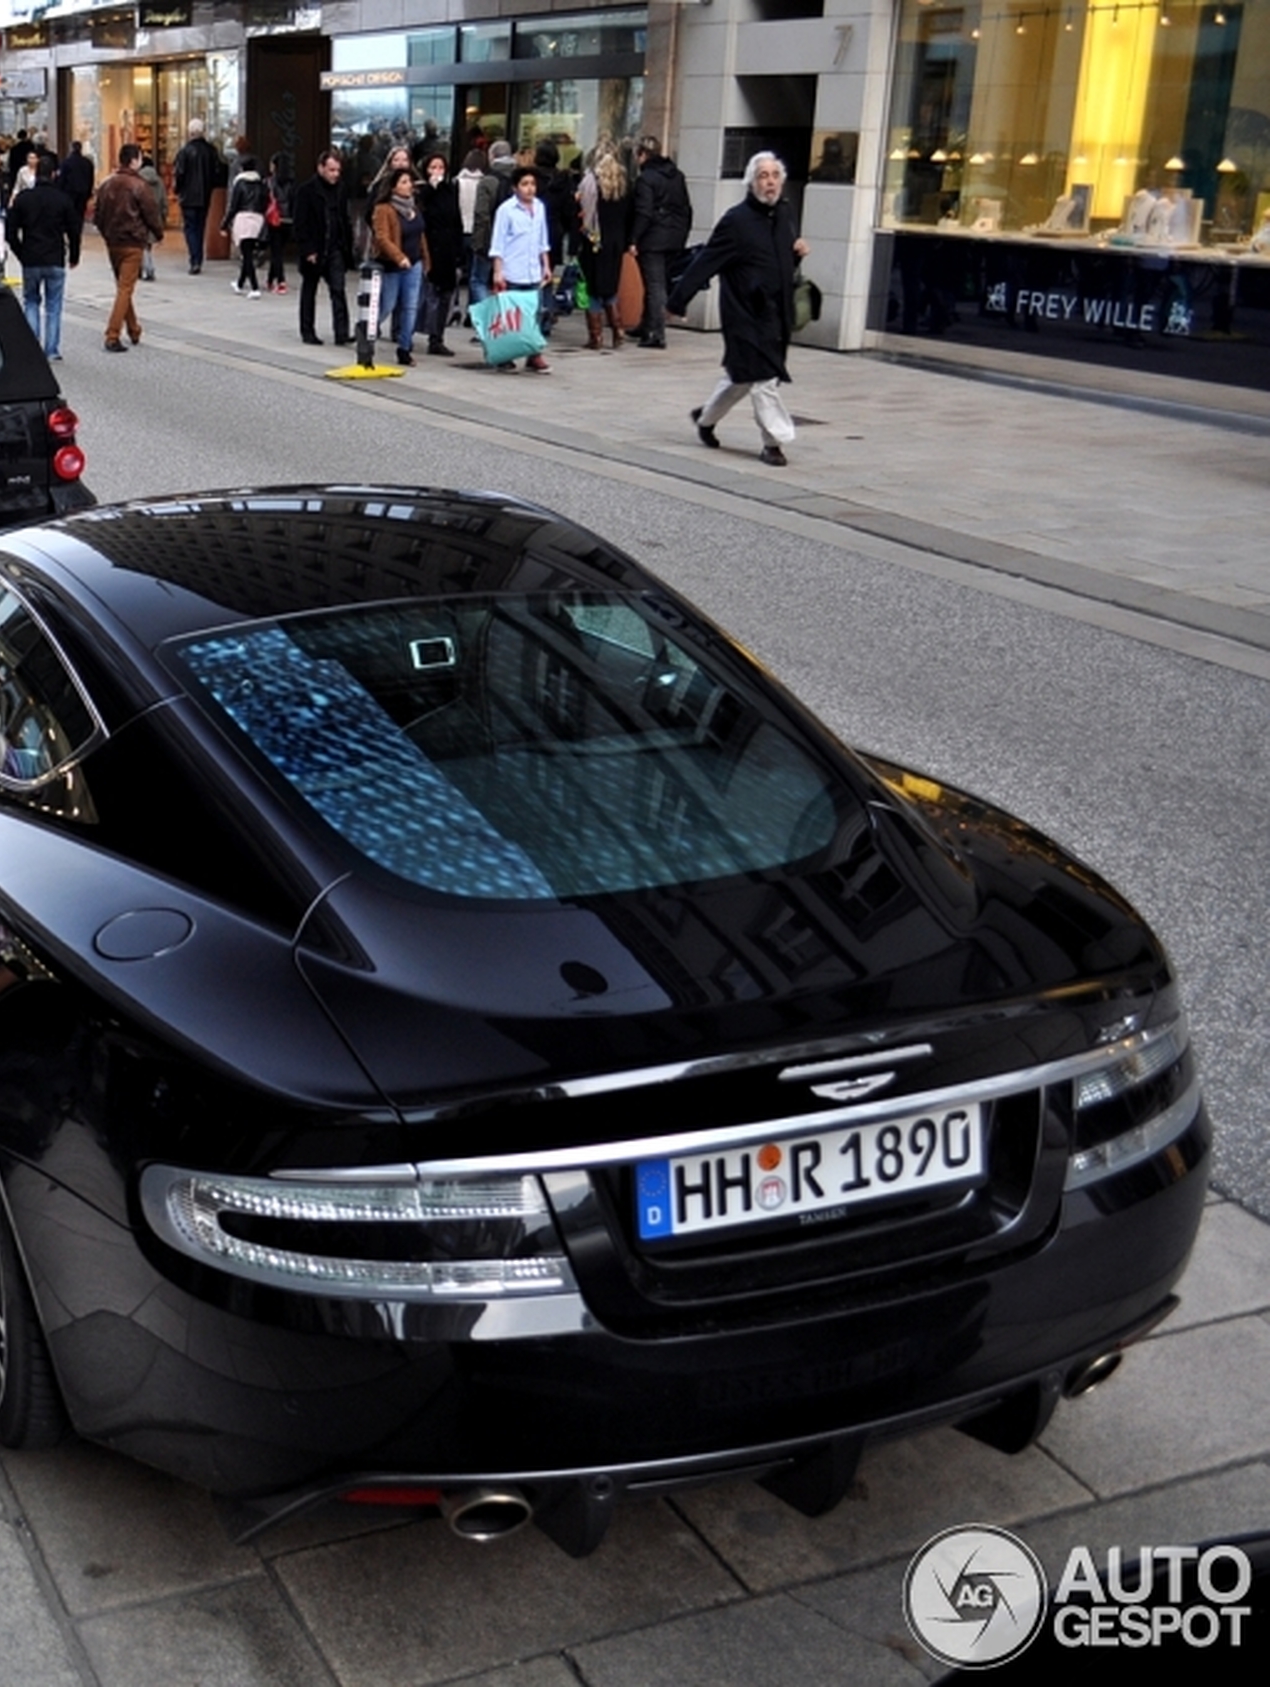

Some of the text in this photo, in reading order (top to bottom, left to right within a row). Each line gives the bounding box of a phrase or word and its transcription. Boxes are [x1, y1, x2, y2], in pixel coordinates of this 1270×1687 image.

[833, 25, 853, 66] 7
[1016, 289, 1156, 331] FREY WILLE
[646, 1109, 971, 1225] D HH R 1890
